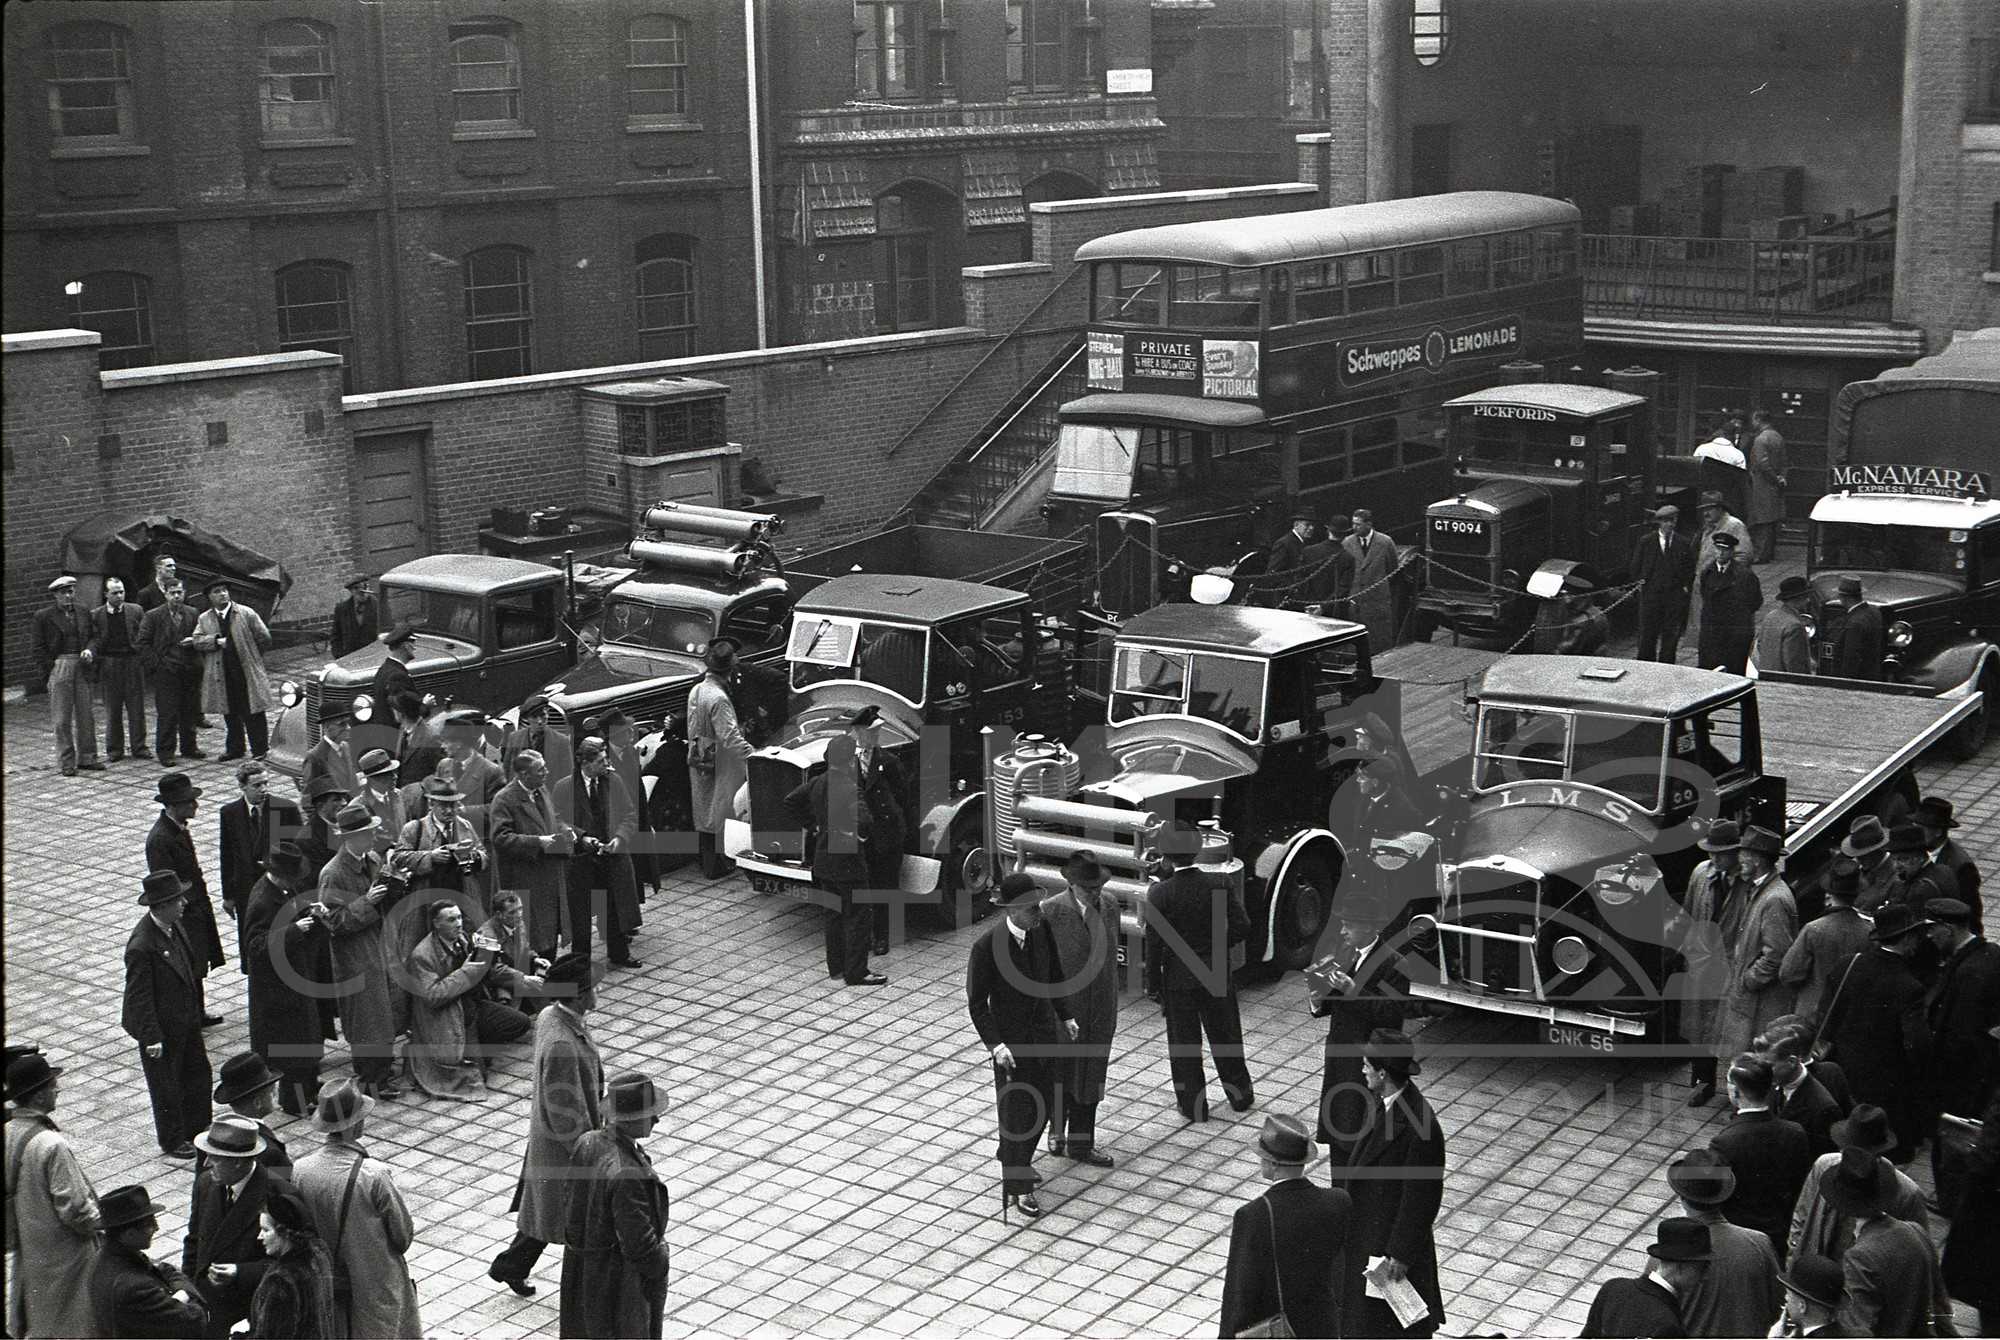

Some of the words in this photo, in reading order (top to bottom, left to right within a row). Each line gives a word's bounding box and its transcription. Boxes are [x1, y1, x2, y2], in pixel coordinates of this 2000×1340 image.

[1141, 341, 1191, 356] PRIVATE
[1348, 345, 1421, 374] Schweppes
[1450, 326, 1517, 354] LEMONADE
[1203, 378, 1259, 396] PICTORIAL
[1473, 404, 1557, 422] PICKFORDS
[1857, 485, 1905, 493] EXPRESS
[1912, 486, 1960, 498] SERVICE
[1434, 520, 1450, 532] GT
[1451, 521, 1482, 534] 9094
[1549, 1028, 1584, 1048] CNK
[1590, 1034, 1614, 1052] 56
